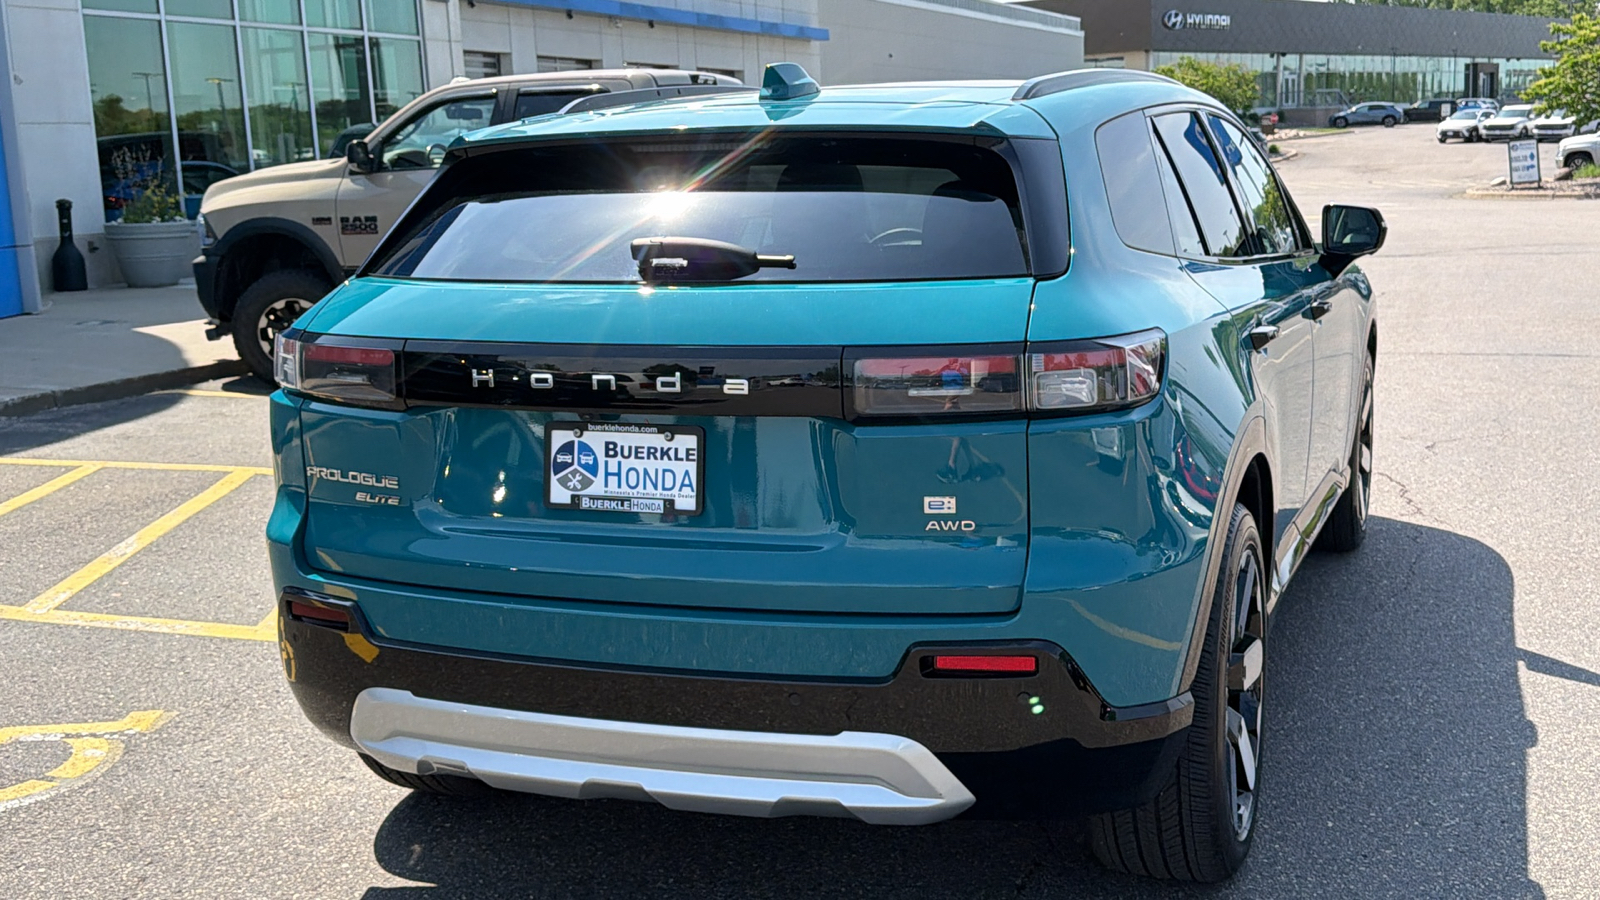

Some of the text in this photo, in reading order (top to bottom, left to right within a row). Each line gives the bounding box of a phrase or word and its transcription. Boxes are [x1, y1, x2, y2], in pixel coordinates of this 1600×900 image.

[1186, 13, 1231, 26] HYUNDAI
[341, 223, 378, 231] 2500
[587, 423, 659, 433] buerklehonda.com
[604, 441, 696, 462] BUERKLE
[306, 466, 399, 489] PROLOGUE
[604, 460, 695, 493] HONDA
[355, 492, 400, 505] ELITE
[925, 520, 976, 531] AWD
